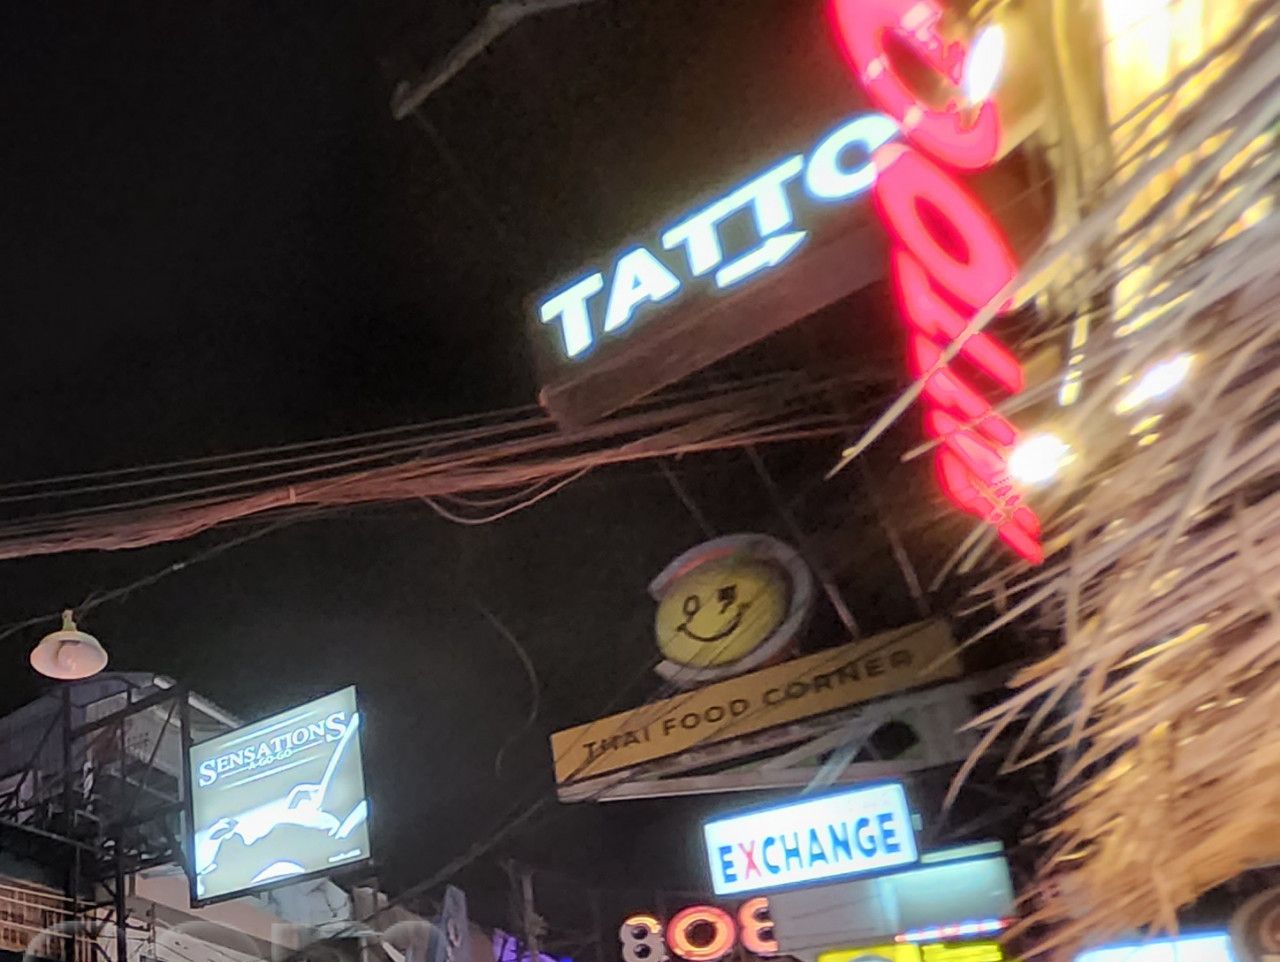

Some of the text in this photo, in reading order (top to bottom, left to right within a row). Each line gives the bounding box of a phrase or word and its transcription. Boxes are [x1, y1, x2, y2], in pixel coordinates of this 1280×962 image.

[582, 648, 913, 762] THAI FOOD CORNER
[199, 711, 347, 788] SENSATIONS
[719, 812, 901, 884] EXCHANGE
